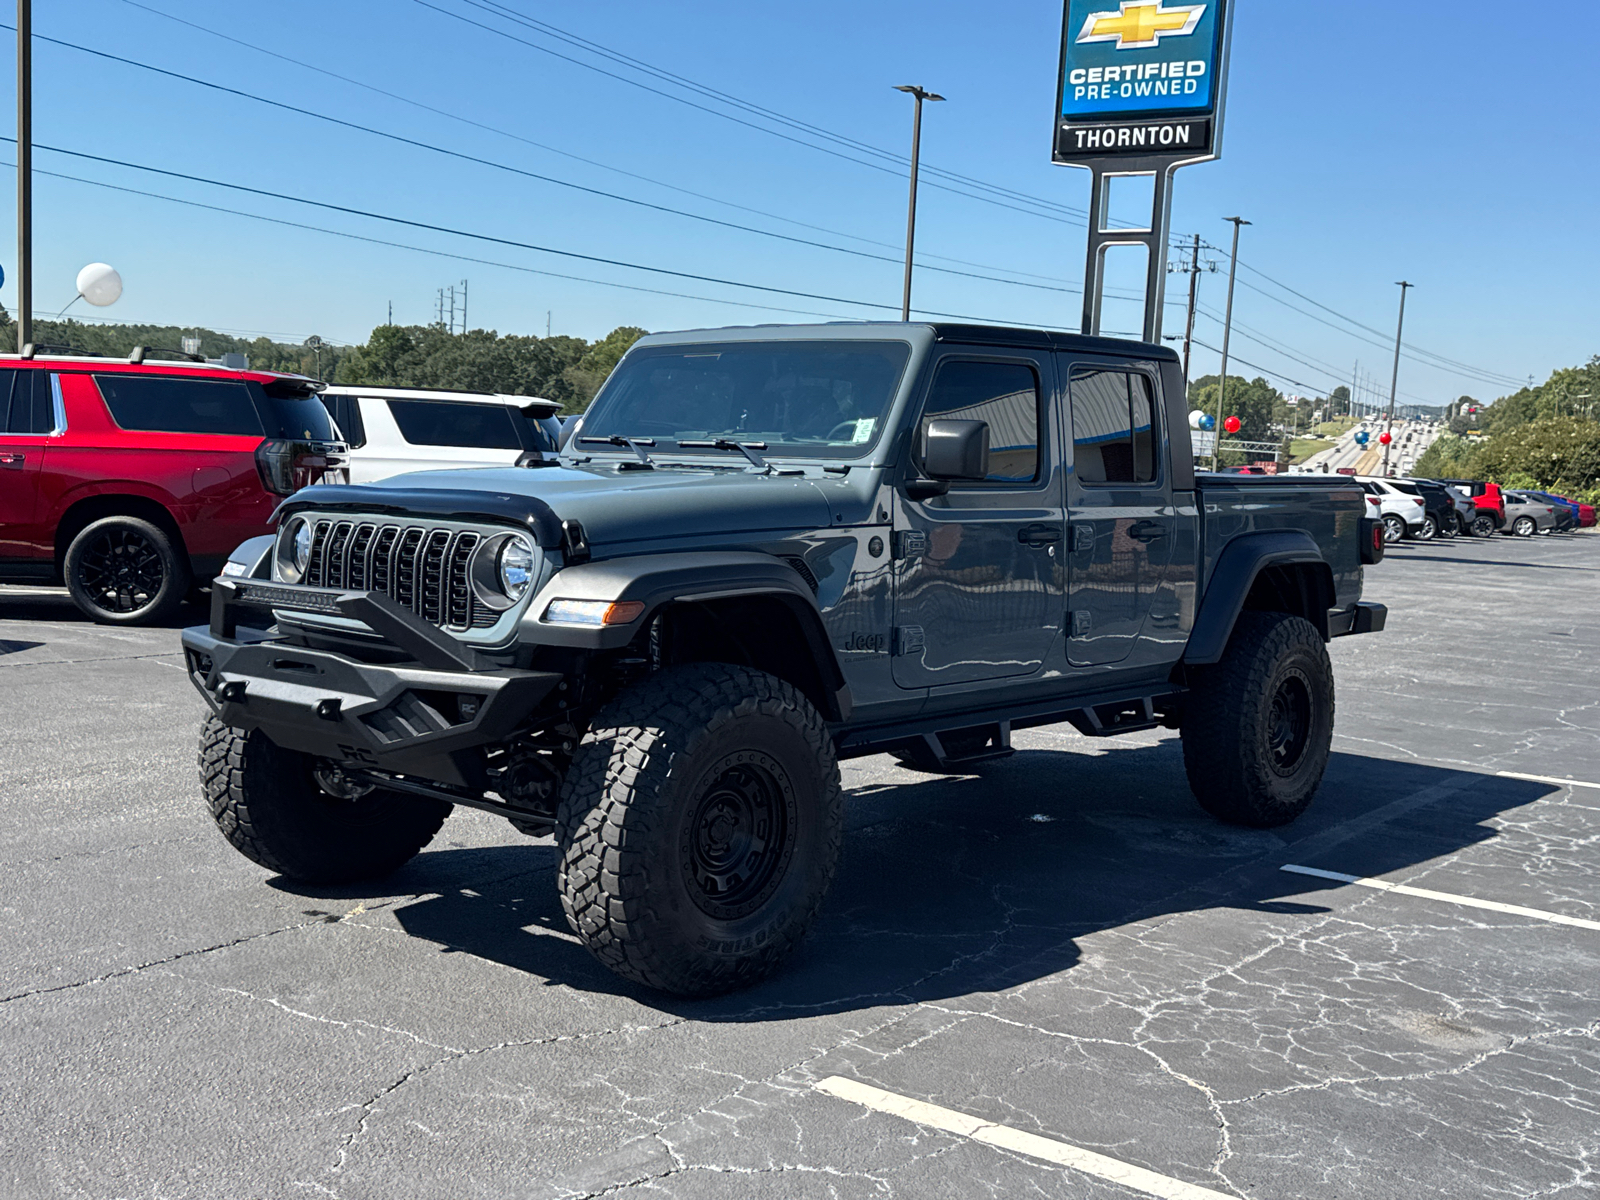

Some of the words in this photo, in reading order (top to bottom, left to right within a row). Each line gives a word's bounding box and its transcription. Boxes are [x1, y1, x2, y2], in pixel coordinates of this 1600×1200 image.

[1069, 60, 1206, 85] CERTIFIED
[1074, 78, 1197, 101] PRE-OWNED
[1075, 125, 1190, 148] THORNTON
[844, 630, 884, 653] Jeep
[461, 703, 476, 714] RC
[336, 743, 379, 765] RC
[755, 911, 787, 945] OYO
[695, 933, 753, 953] TIRES
